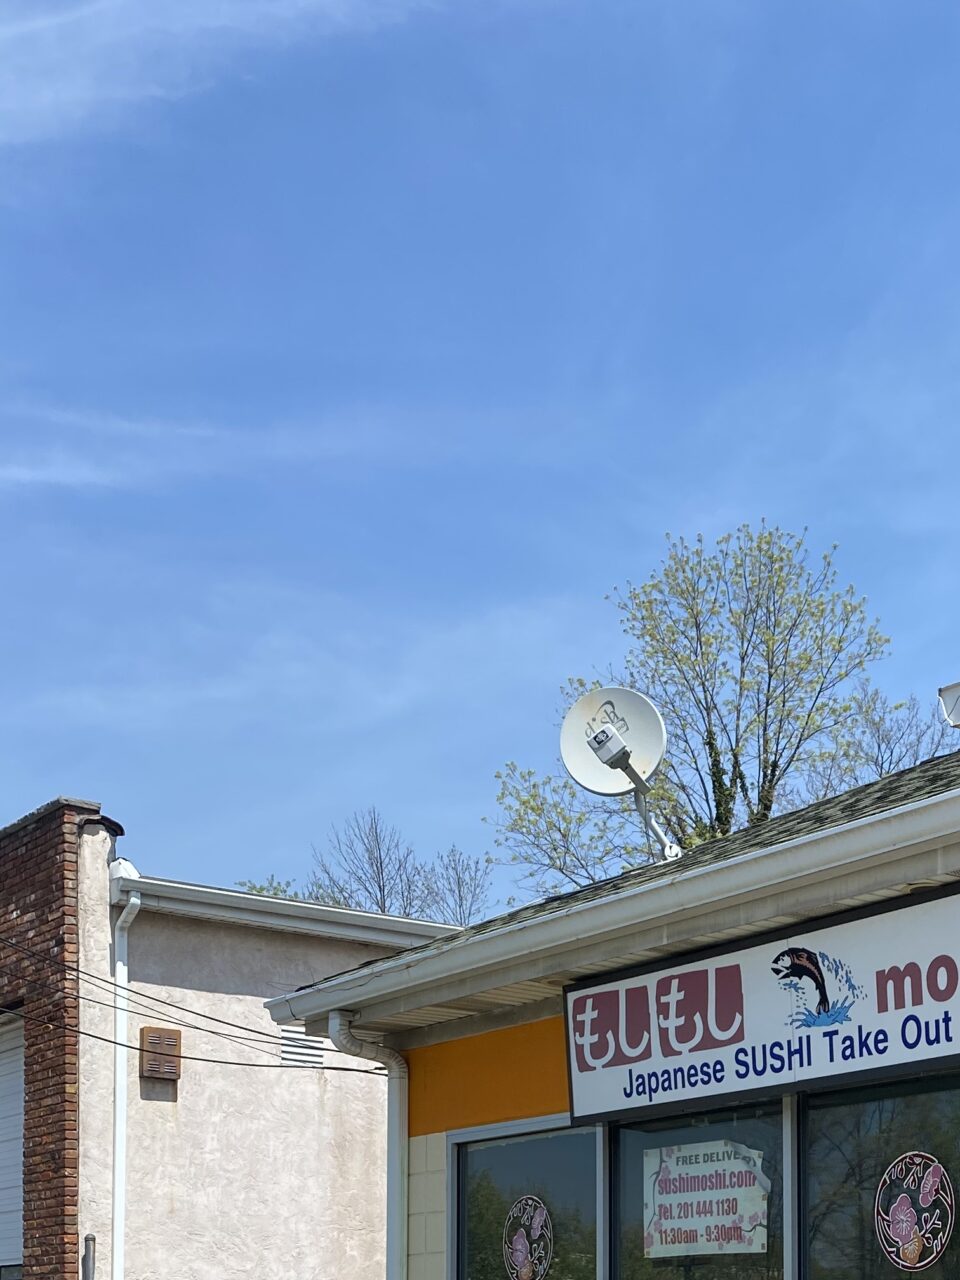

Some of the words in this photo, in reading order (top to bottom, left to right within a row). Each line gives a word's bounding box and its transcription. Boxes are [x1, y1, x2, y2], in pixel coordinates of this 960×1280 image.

[573, 966, 746, 1070] もしもし
[622, 1059, 726, 1100] Japanese
[735, 1037, 812, 1076] SUSHI
[823, 1025, 889, 1063] Take
[901, 1010, 953, 1051] Out
[676, 1154, 701, 1166] FREE
[658, 1169, 757, 1196] sushimoshi.com
[658, 1203, 675, 1220] Tel.
[677, 1202, 694, 1219] 201
[696, 1200, 713, 1217] 444
[716, 1198, 738, 1215] 1130
[658, 1228, 698, 1245] 11:30am
[705, 1224, 742, 1243] 9:30pm
